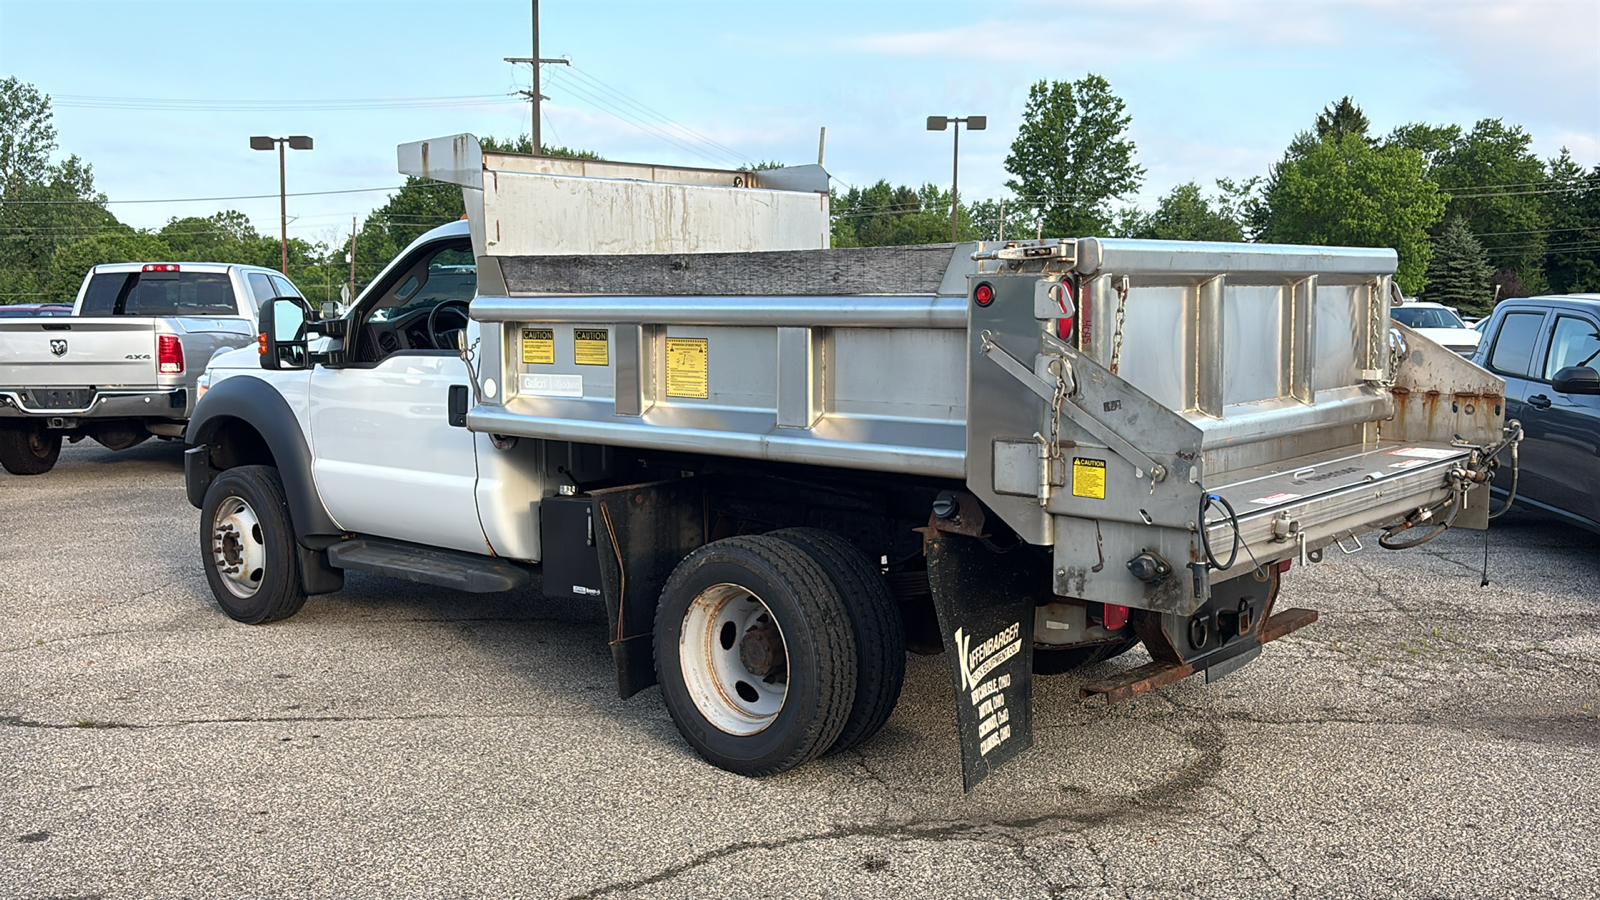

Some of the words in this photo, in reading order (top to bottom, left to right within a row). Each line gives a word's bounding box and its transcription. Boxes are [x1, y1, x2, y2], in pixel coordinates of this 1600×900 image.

[523, 331, 552, 340] CAUTION
[576, 332, 606, 340] CAUTION
[1080, 459, 1105, 467] CAUTION
[983, 649, 1008, 673] EQUIPMENT
